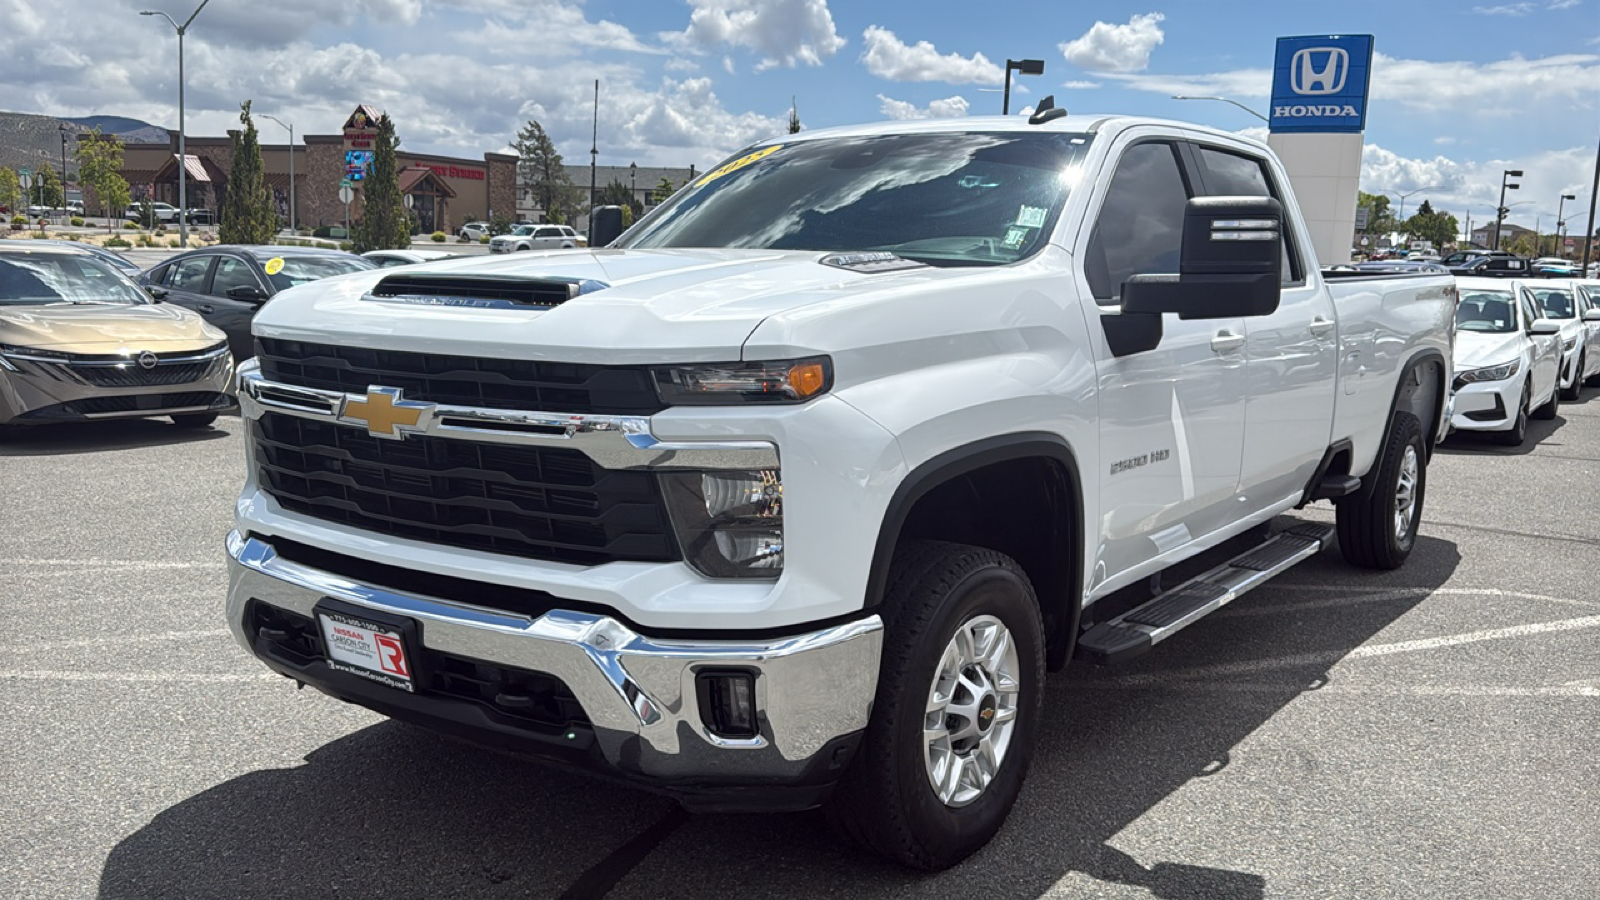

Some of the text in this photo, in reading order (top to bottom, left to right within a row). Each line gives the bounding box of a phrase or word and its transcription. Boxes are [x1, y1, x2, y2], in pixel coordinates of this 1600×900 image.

[1273, 105, 1359, 117] HONDA
[415, 161, 448, 177] LKY
[333, 626, 365, 641] NISSAN
